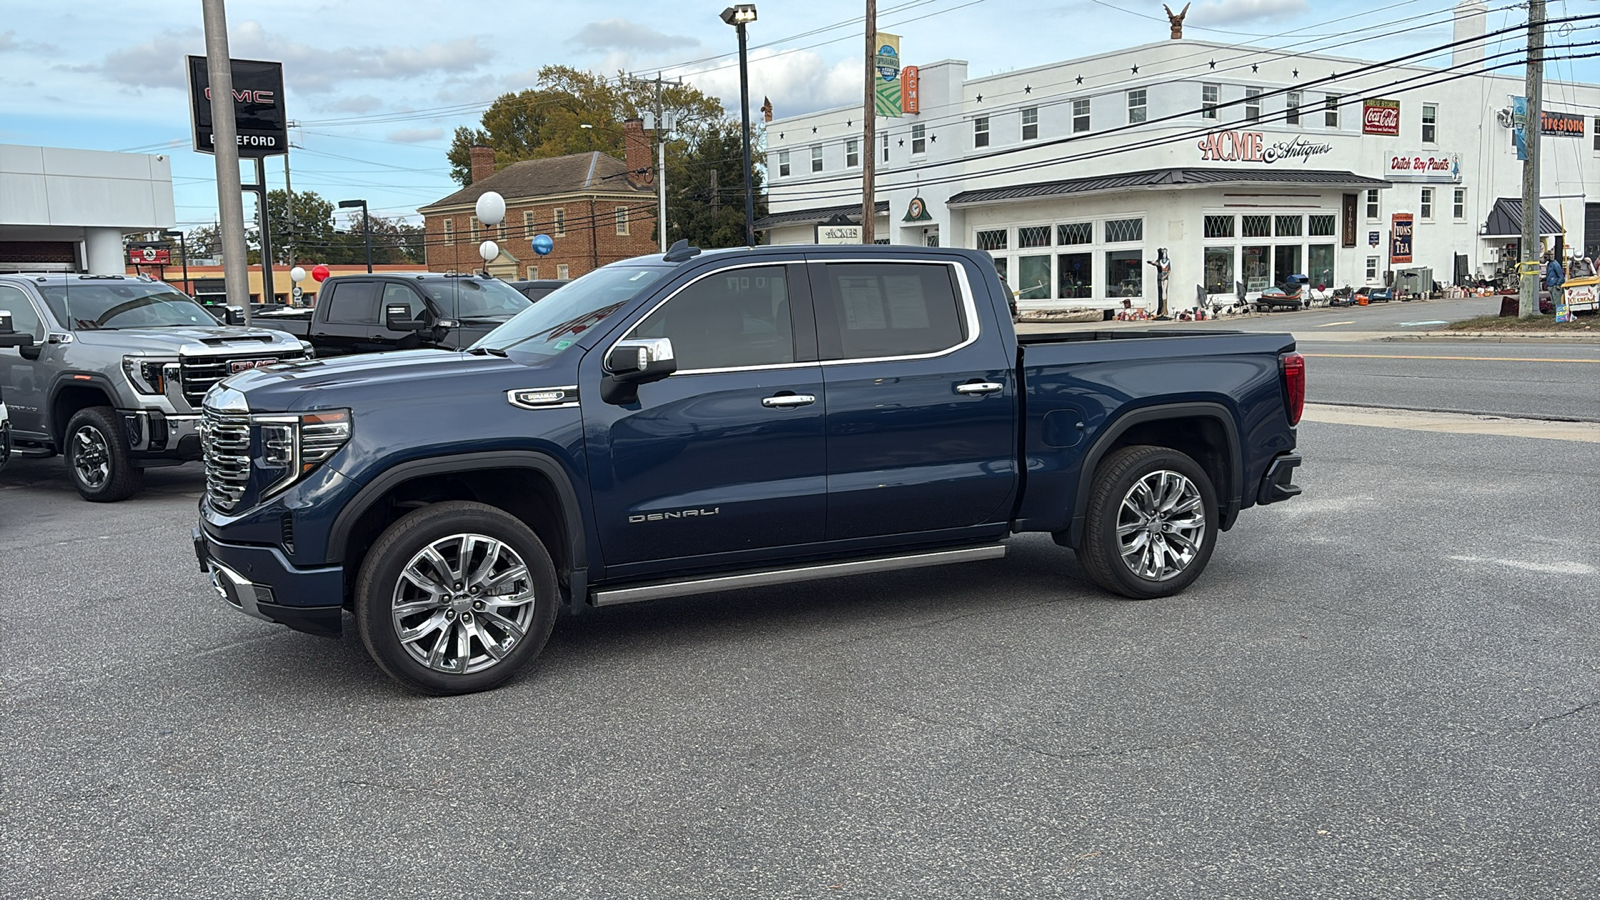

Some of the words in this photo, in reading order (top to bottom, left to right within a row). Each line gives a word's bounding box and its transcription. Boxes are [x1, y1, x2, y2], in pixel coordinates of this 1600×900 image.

[908, 69, 917, 110] ACME
[209, 134, 276, 146] BEFORD
[1198, 131, 1263, 162] ACME
[1263, 134, 1332, 164] Antiques
[1391, 156, 1411, 170] Dutch
[1413, 157, 1427, 173] Boy
[1427, 157, 1449, 171] Paints
[1395, 242, 1409, 254] TEA
[628, 507, 719, 523] DENALI
